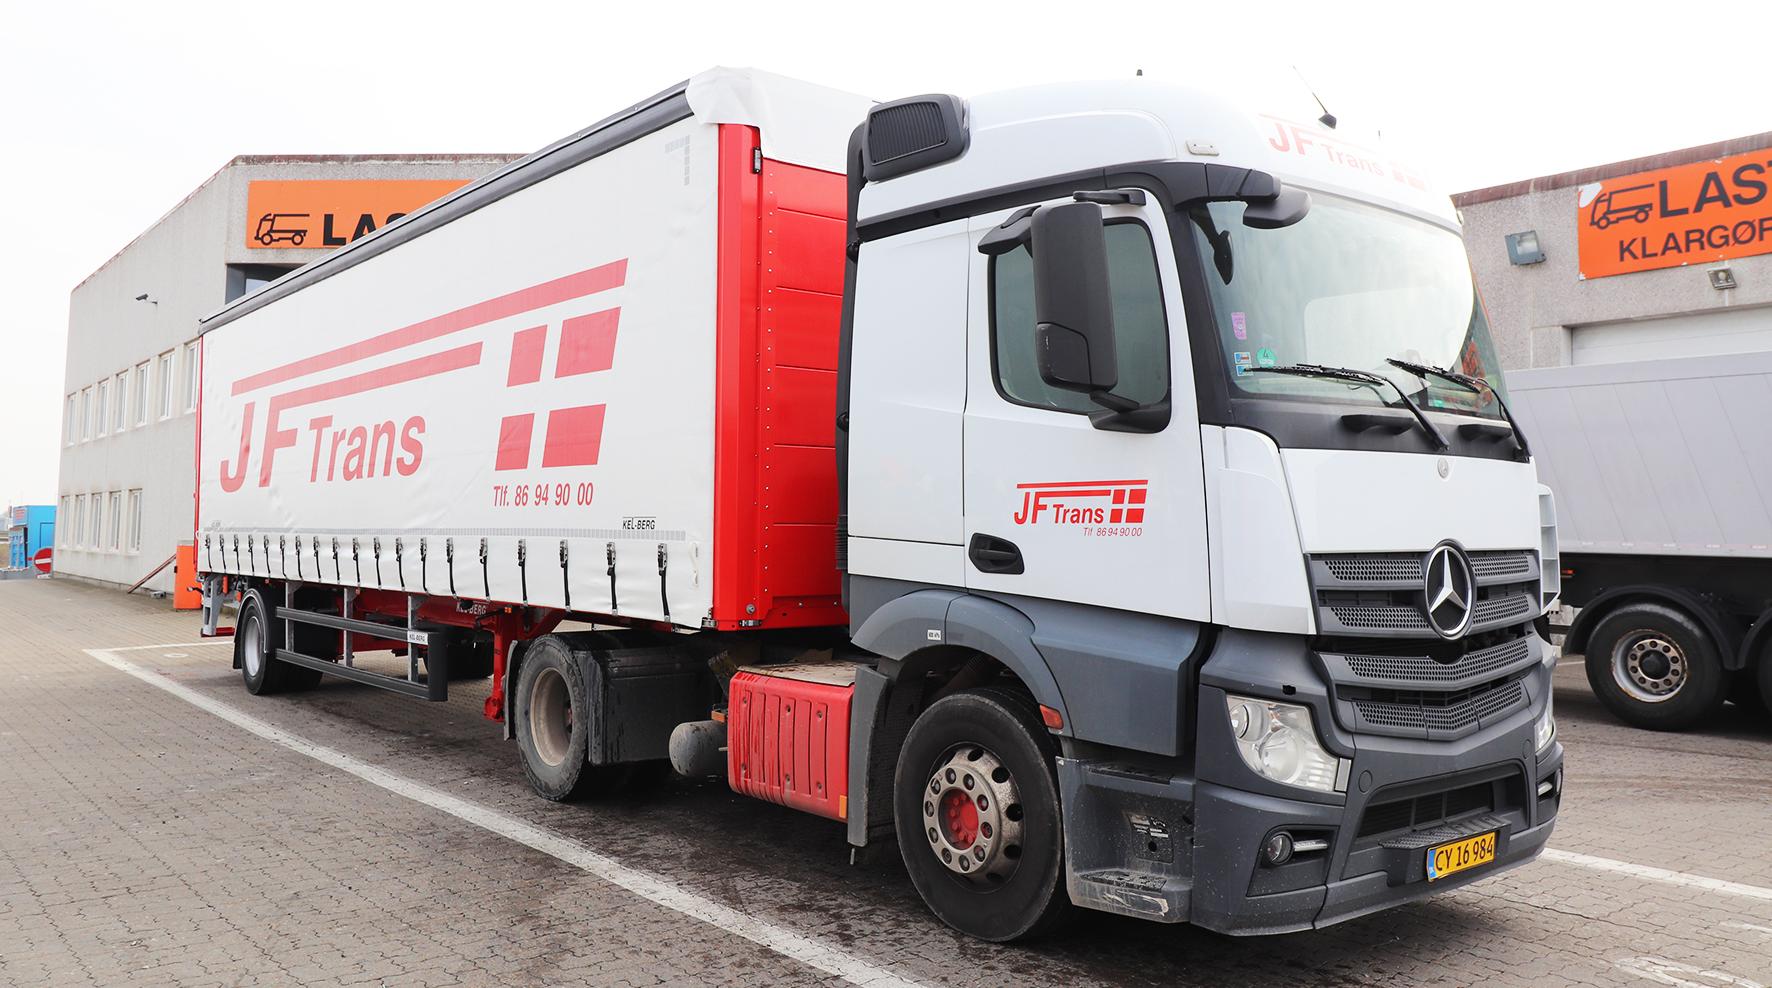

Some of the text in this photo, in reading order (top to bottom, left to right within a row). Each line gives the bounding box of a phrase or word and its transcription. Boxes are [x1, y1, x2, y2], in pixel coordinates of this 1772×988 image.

[1269, 123, 1385, 177] JF Trans
[1659, 160, 1772, 218] LAS
[220, 396, 426, 493] JF Trans
[493, 482, 593, 507] Tlf. 86 94 90 00
[1014, 491, 1104, 525] JF Trans
[622, 517, 656, 530] KEL-BERG
[1096, 527, 1106, 537] 86
[1107, 527, 1118, 537] 94
[1119, 527, 1130, 537] 90
[1131, 527, 1142, 537] 00
[1435, 848, 1453, 872] CY
[1456, 843, 1470, 867] 16
[1473, 836, 1494, 862] 984
